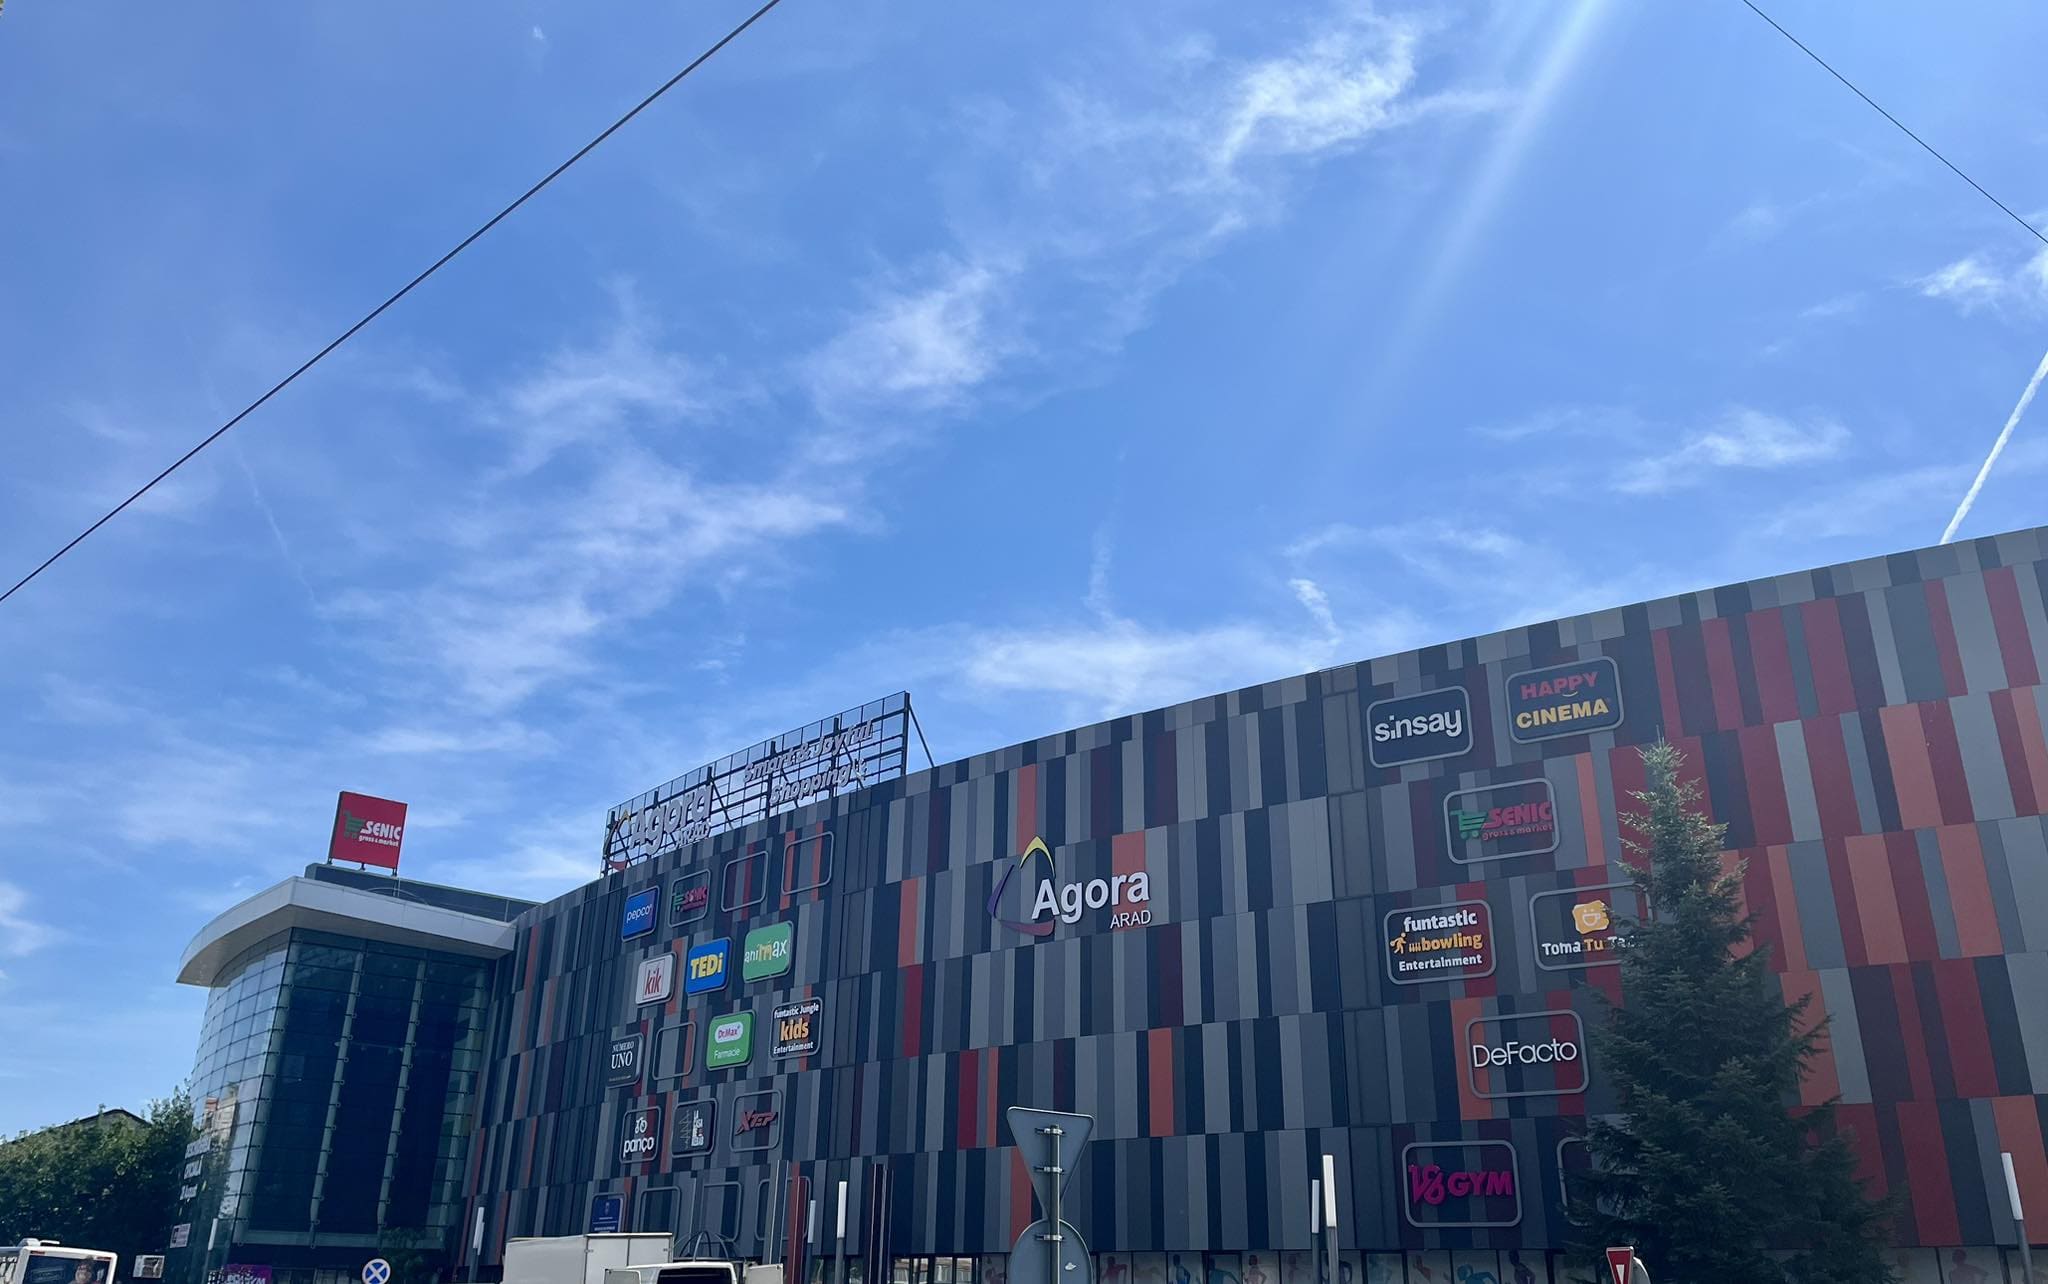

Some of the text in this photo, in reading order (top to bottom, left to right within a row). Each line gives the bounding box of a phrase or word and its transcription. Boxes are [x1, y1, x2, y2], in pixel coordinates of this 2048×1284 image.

[1520, 672, 1598, 700] HAPPY
[1374, 709, 1463, 742] sinsay
[1516, 698, 1609, 729] CINEMA
[770, 763, 852, 804] Shopping
[628, 783, 713, 856] Agora
[1481, 801, 1553, 830] SENIC
[361, 821, 401, 840] SENIC
[1031, 870, 1151, 924] Agora
[1110, 909, 1152, 930] ARAD
[1403, 910, 1478, 933] funtastic
[1420, 932, 1483, 952] bowling
[1541, 941, 1582, 956] Toma
[1584, 938, 1604, 951] Tu
[691, 952, 724, 980] TEDi
[1398, 954, 1483, 972] Entertainment
[644, 967, 662, 995] kik
[780, 1017, 809, 1042] kids
[611, 1050, 633, 1069] UNO
[1472, 1038, 1577, 1068] DeFacto
[1447, 1171, 1513, 1197] GYM
